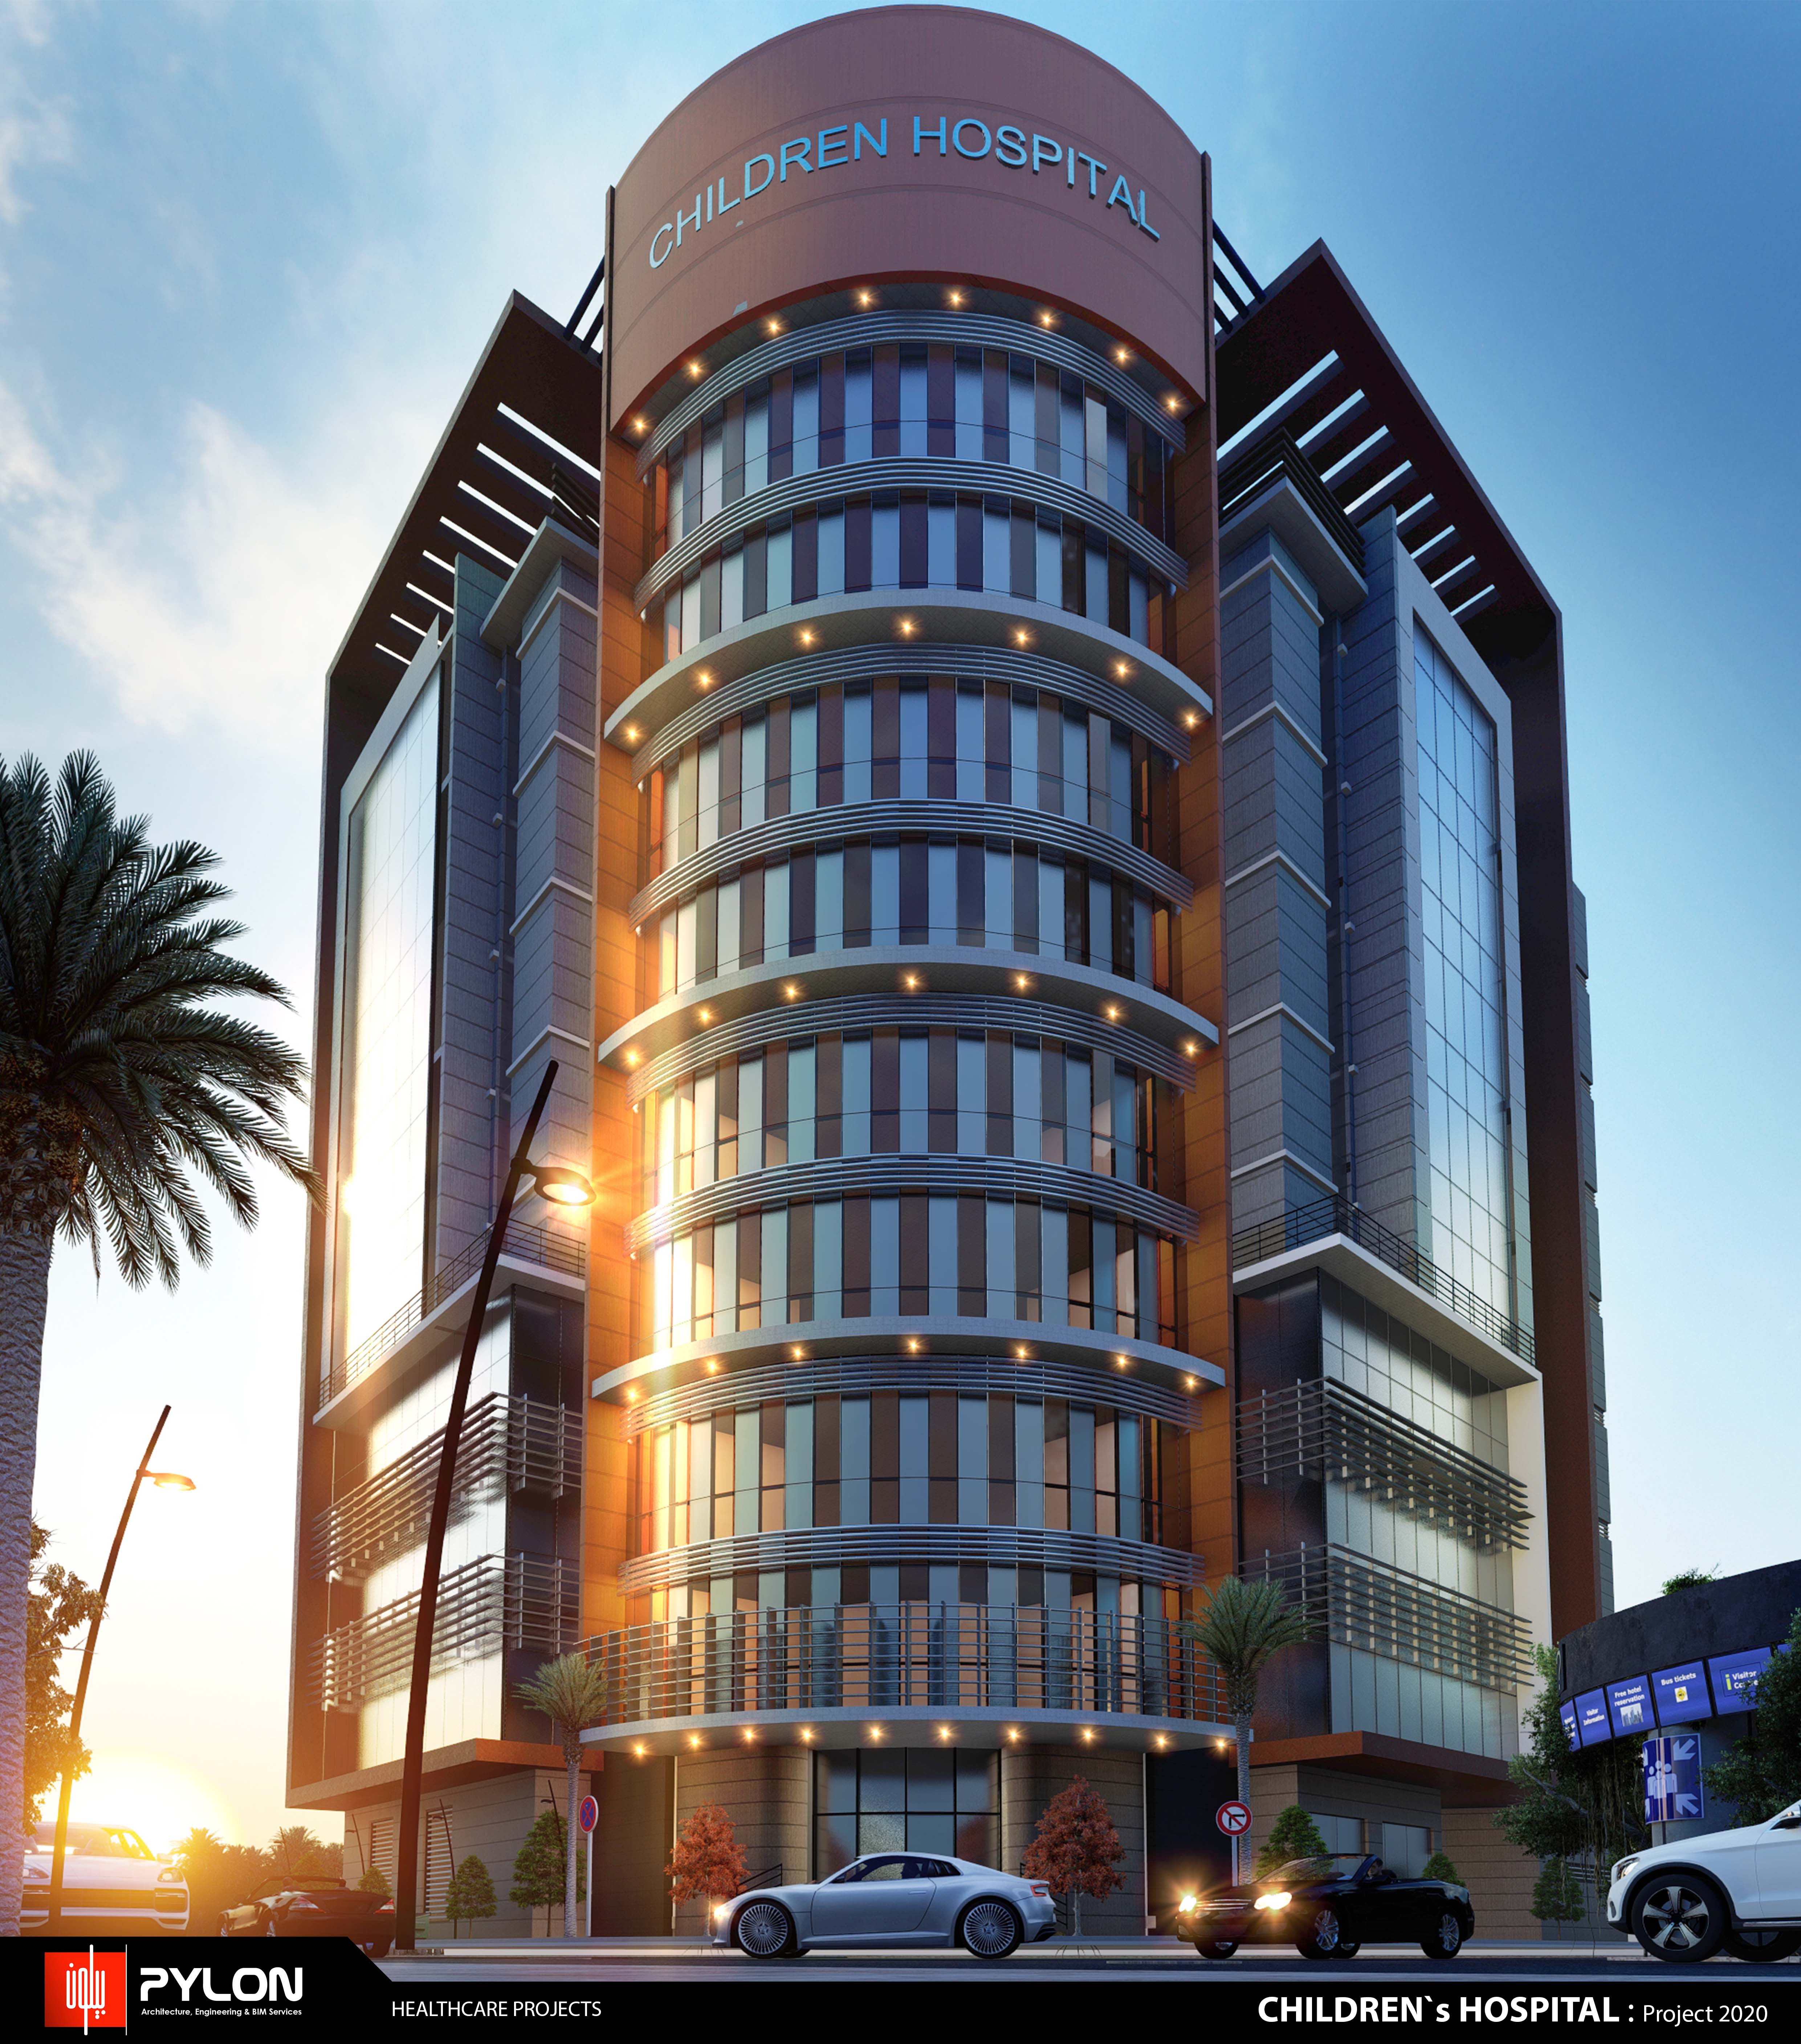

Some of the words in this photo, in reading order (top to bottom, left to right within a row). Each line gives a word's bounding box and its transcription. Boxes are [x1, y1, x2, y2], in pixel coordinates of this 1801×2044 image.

[649, 118, 888, 269] CHILDREN
[912, 115, 1160, 241] HOSPITAL
[1674, 1673, 1697, 1683] tickets
[1732, 1671, 1757, 1680] Visitor
[1627, 1685, 1642, 1694] hotel
[1614, 1694, 1645, 1706] reservation
